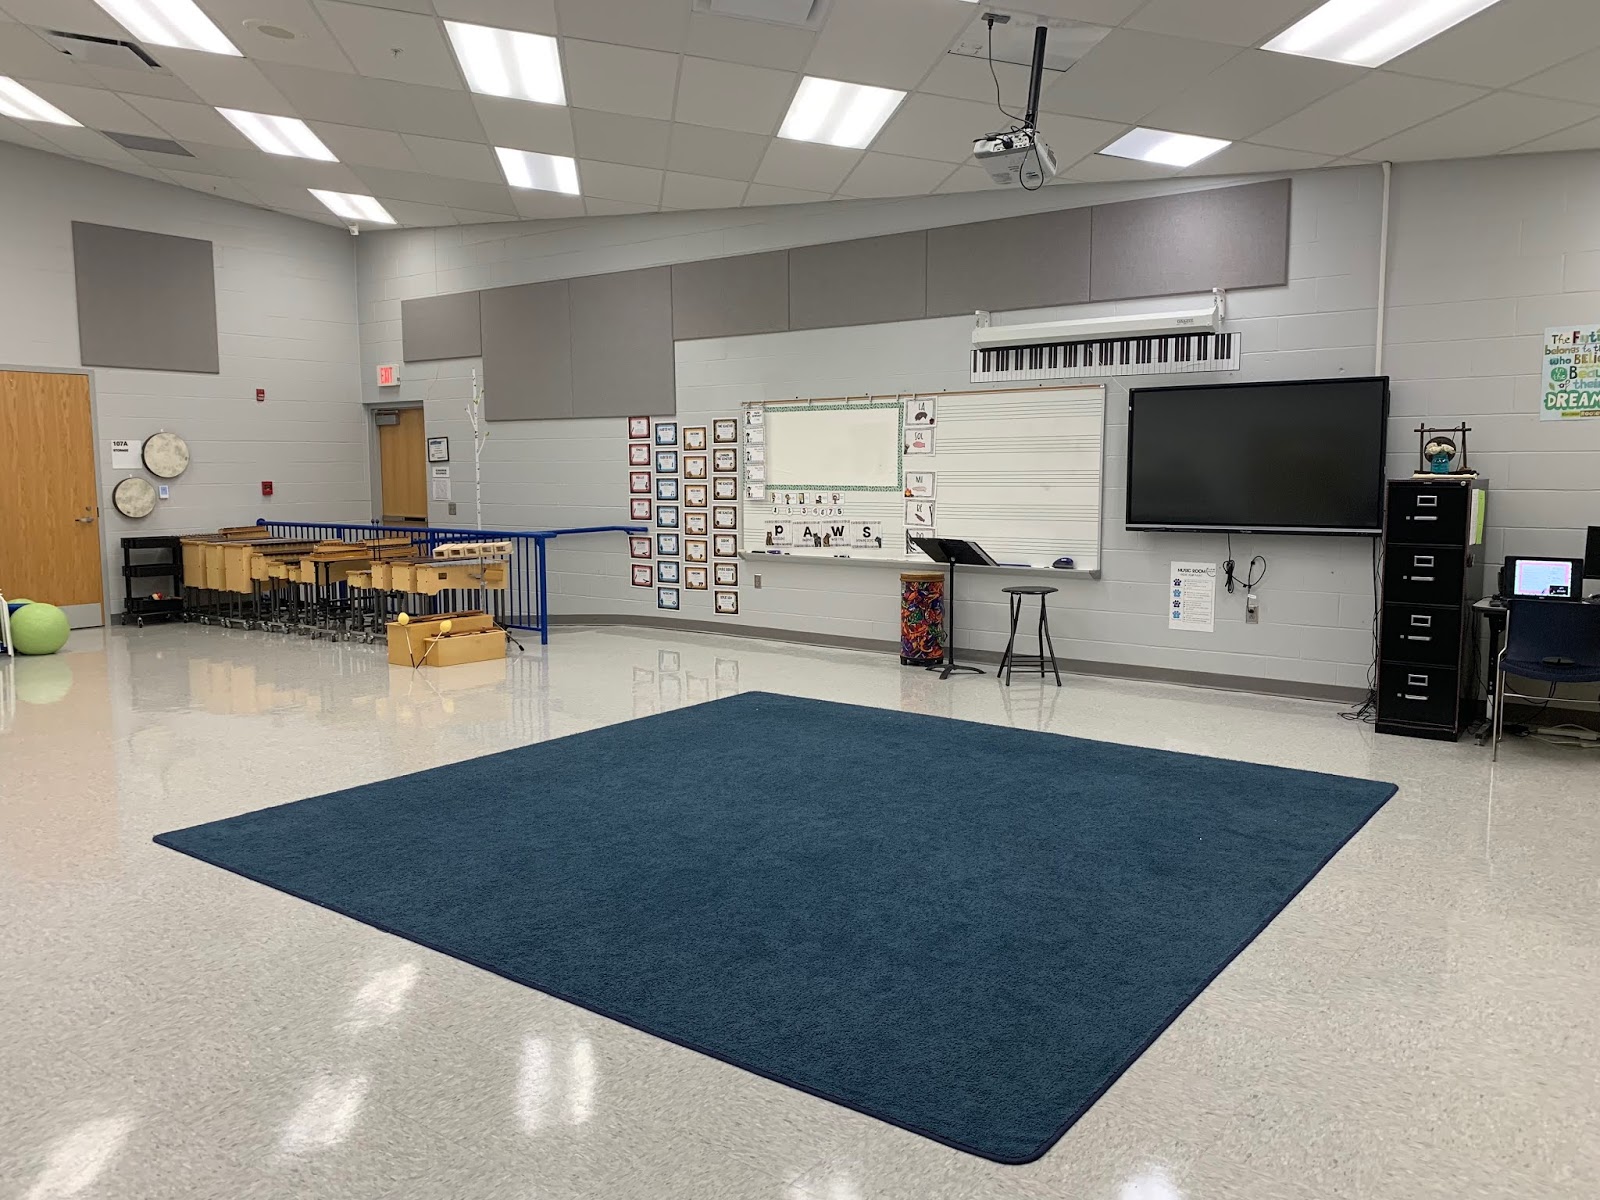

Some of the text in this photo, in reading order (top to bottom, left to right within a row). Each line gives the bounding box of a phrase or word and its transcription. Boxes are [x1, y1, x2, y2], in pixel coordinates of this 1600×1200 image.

[1551, 334, 1570, 344] The
[1582, 344, 1591, 352] to
[1549, 356, 1572, 365] who
[380, 367, 393, 384] EXIT
[1553, 373, 1566, 381] the
[1558, 379, 1571, 393] of
[918, 402, 926, 411] LA
[914, 432, 924, 440] SOL
[915, 475, 923, 483] MI
[803, 526, 813, 537] A
[831, 525, 845, 537] W
[862, 526, 871, 538] S
